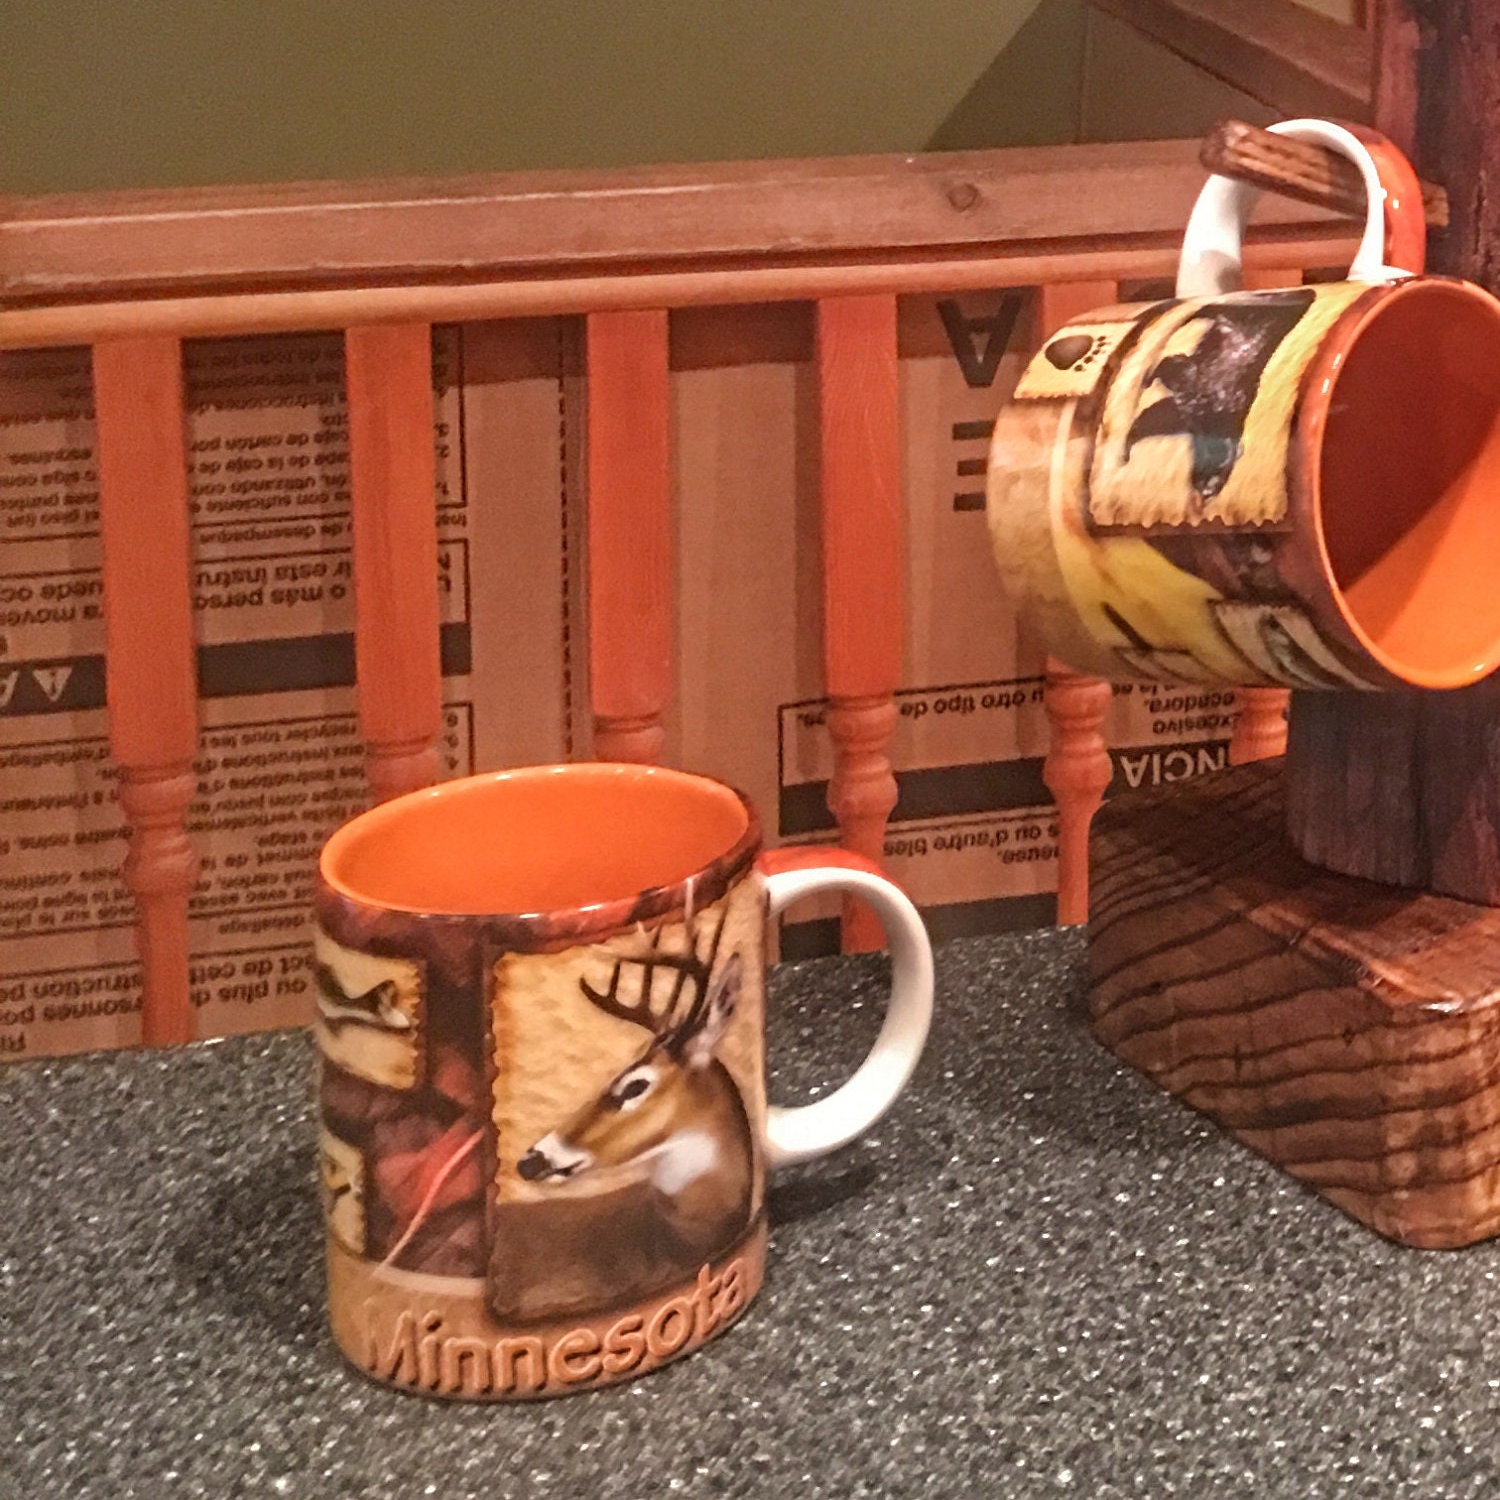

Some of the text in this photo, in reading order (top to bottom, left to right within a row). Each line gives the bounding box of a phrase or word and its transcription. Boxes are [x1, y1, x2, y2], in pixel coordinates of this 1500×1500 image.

[194, 567, 268, 588] instru
[274, 563, 327, 582] esta
[40, 581, 104, 601] uede
[191, 587, 264, 611] perso
[270, 585, 324, 608] más
[900, 702, 928, 719] de
[934, 695, 976, 715] tipo
[981, 690, 1026, 711] otro
[1143, 692, 1235, 715] ecadora.
[1119, 747, 1225, 788] NCIA
[933, 829, 1009, 849] d'autre
[1015, 824, 1042, 843] ou
[883, 838, 928, 858] bles
[218, 981, 269, 1004] plus
[0, 1004, 35, 1025] po
[44, 997, 142, 1021] rsonnes
[361, 1257, 747, 1393] Minnesota
